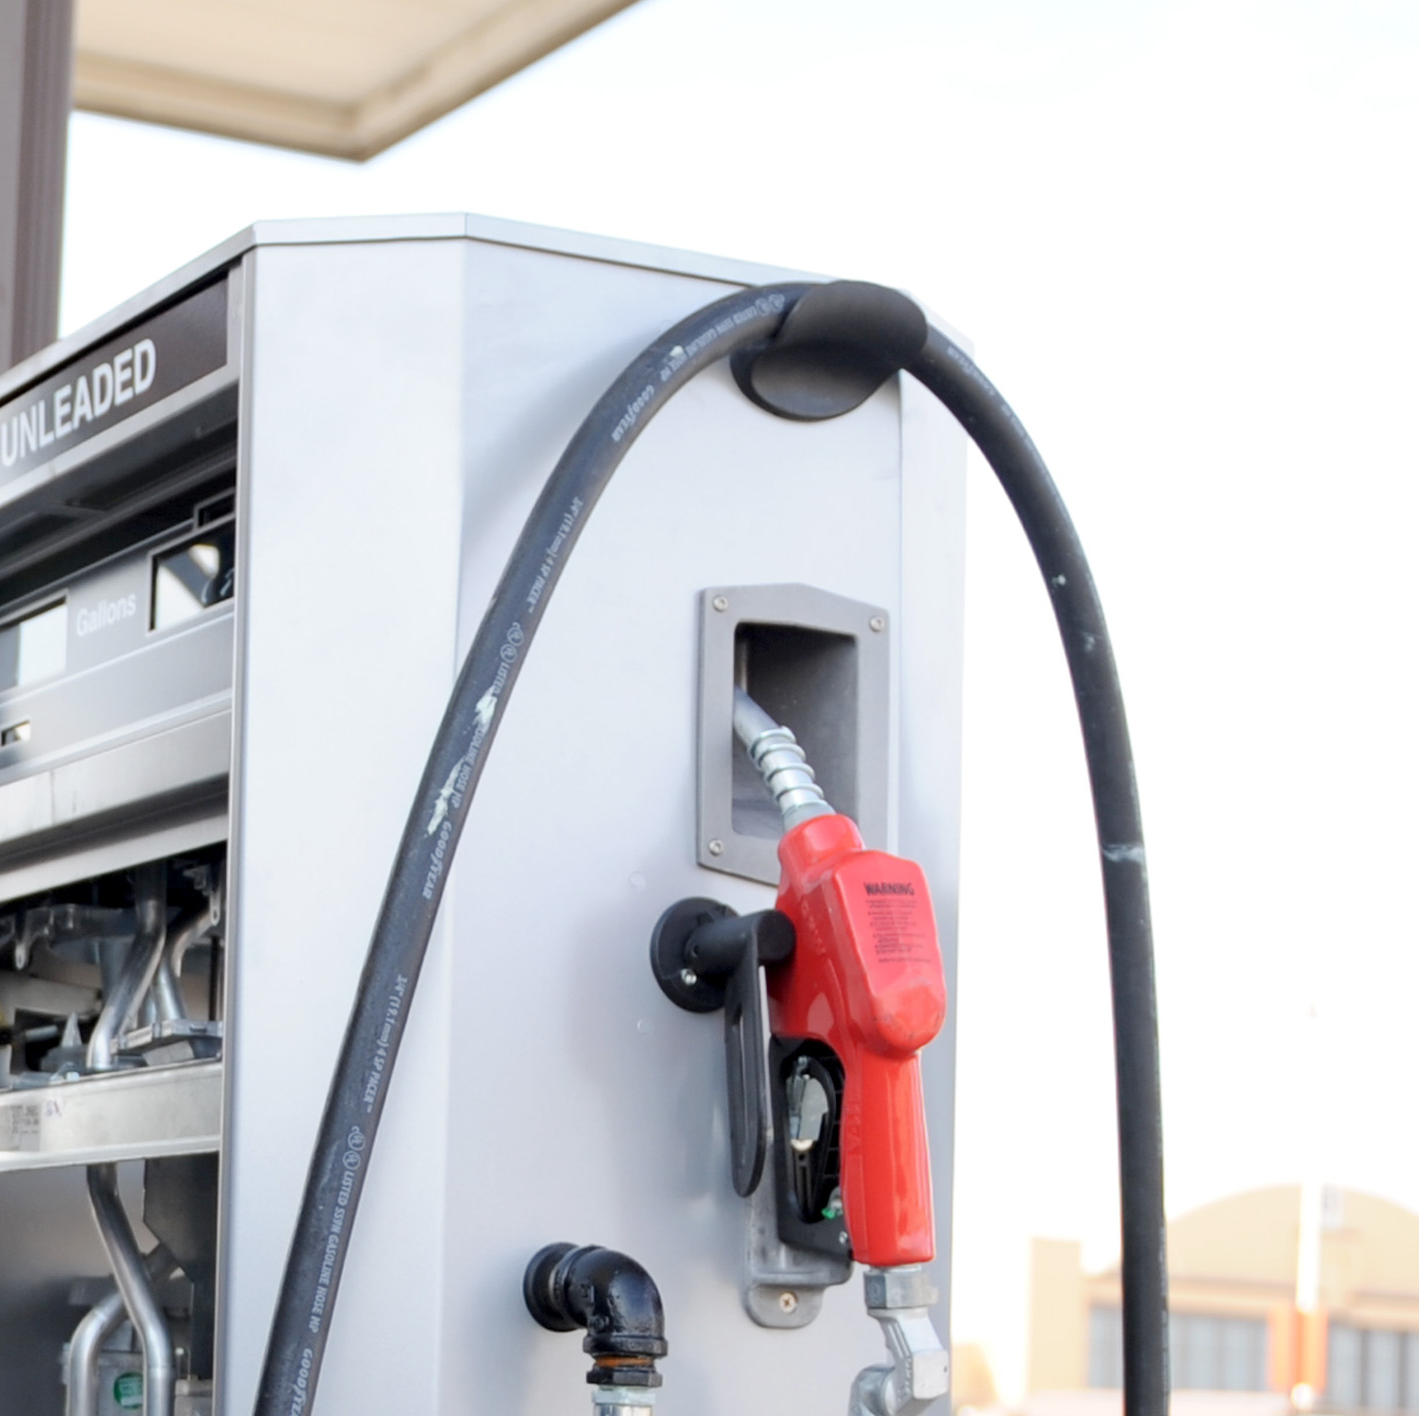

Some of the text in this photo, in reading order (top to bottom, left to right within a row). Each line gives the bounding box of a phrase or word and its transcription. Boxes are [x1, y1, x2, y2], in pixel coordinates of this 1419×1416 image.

[1, 338, 156, 467] UNLEADED
[76, 593, 137, 637] Gallons
[422, 820, 453, 900] GOODYEAR
[863, 882, 915, 896] WARNING
[338, 1170, 355, 1207] LISTED
[319, 1233, 339, 1286] GASOLINE
[312, 1285, 328, 1315] HOSE
[308, 1313, 322, 1334] MP
